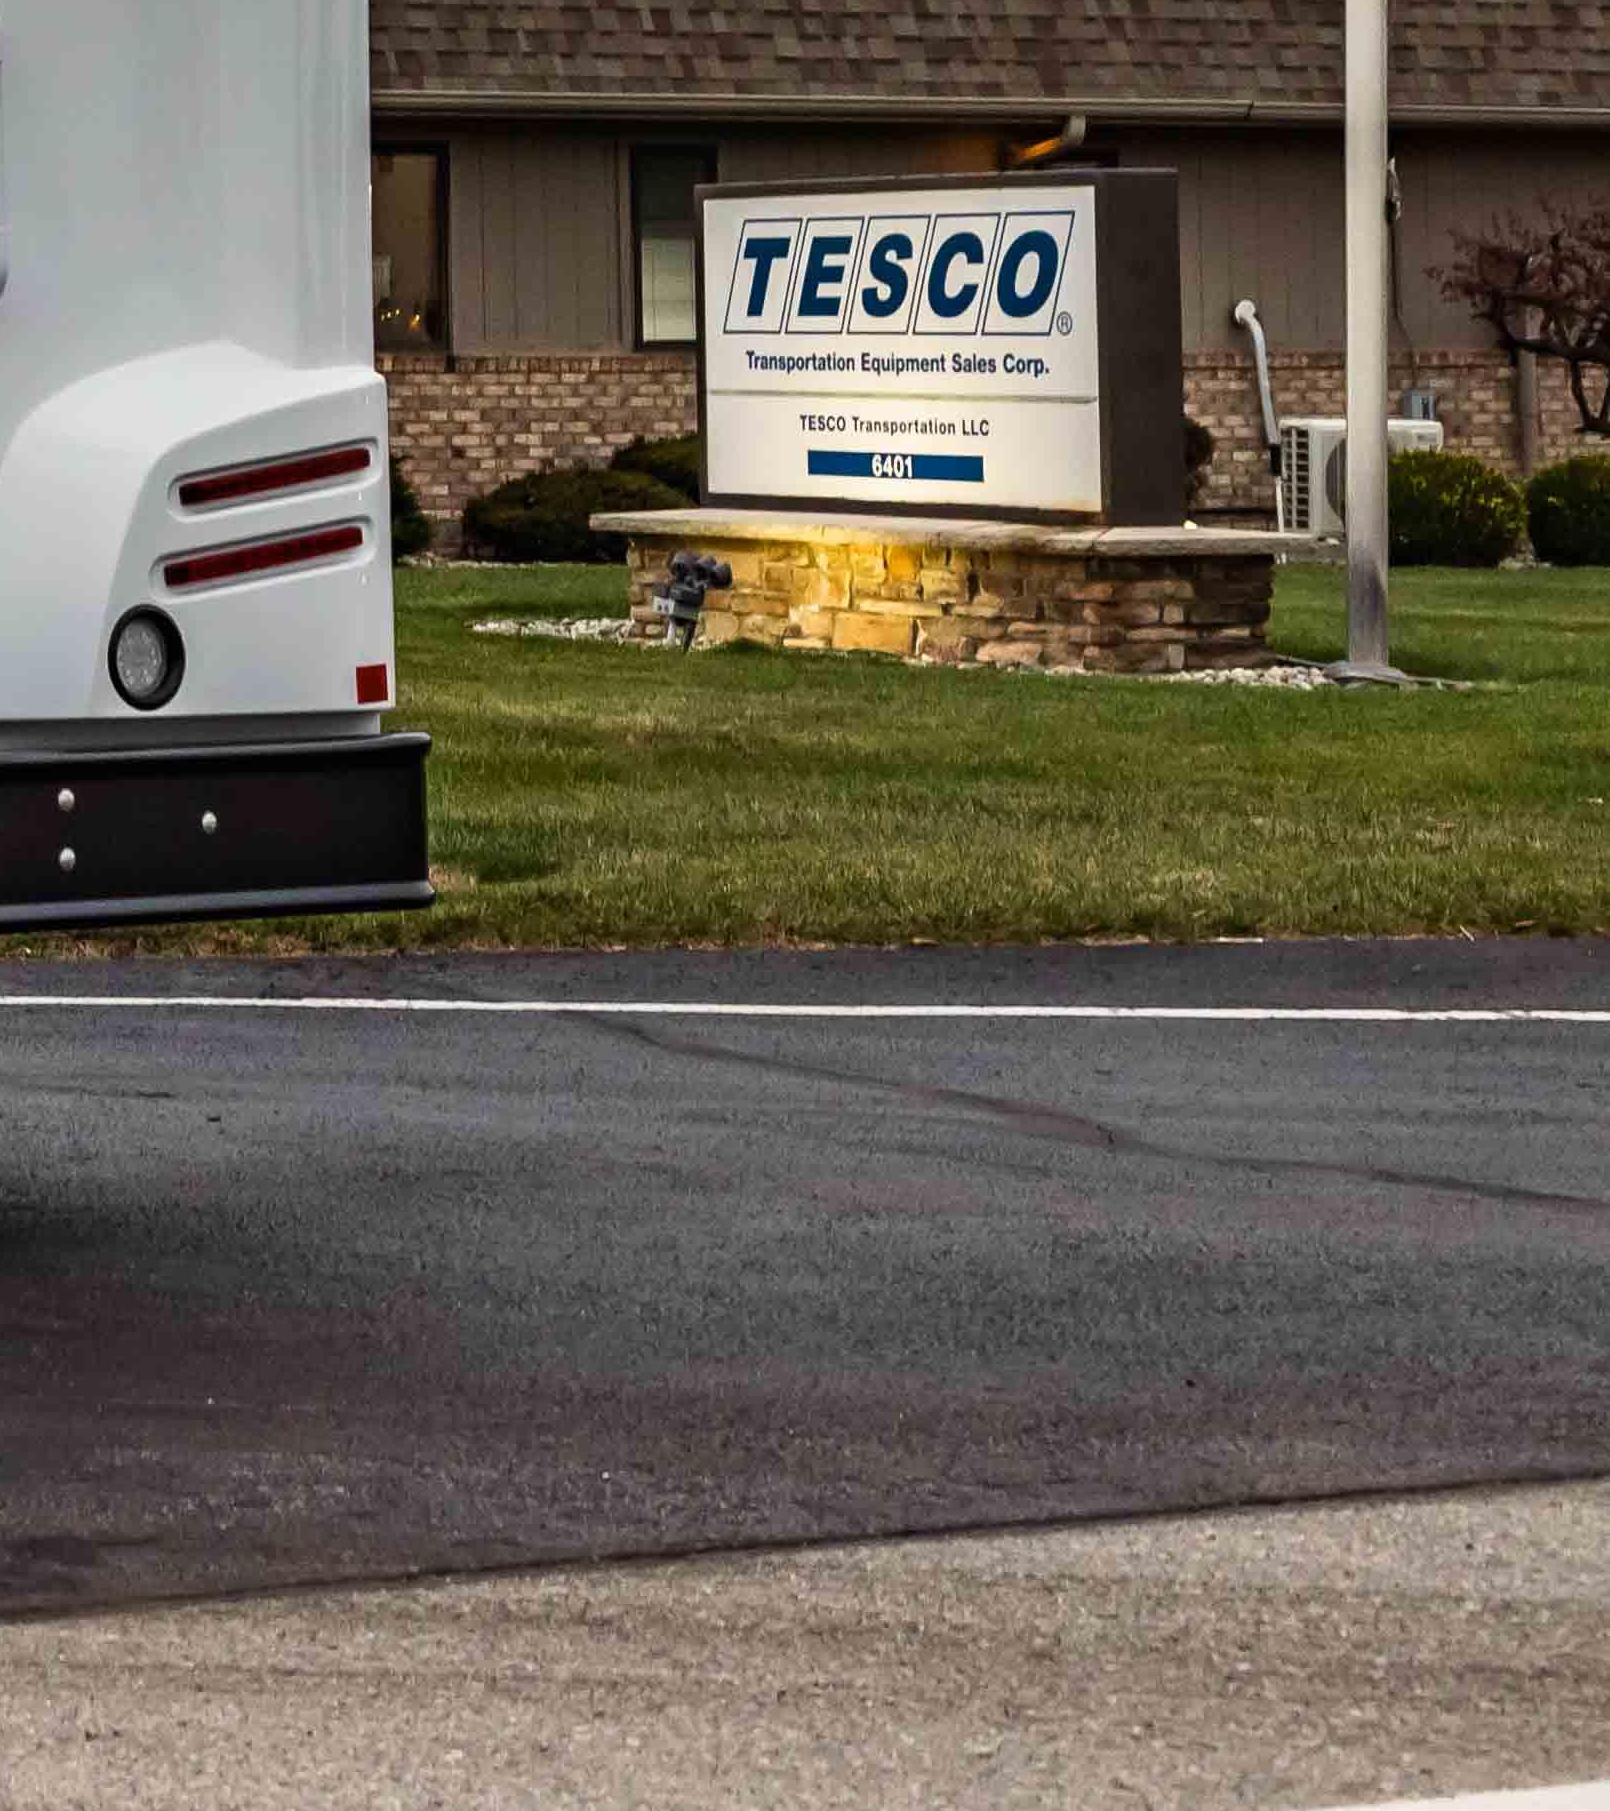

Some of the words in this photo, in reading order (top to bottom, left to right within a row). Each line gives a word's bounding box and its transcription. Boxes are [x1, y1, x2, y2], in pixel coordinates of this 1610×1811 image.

[743, 230, 1060, 318] TESCO
[745, 349, 855, 375] Transportation
[860, 351, 946, 376] Equipment
[952, 353, 997, 374] Sales
[1003, 353, 1050, 378] Corp.
[800, 415, 846, 432] TESCO
[852, 416, 956, 436] Transportation
[962, 419, 990, 436] LLC
[872, 454, 913, 478] 6401
